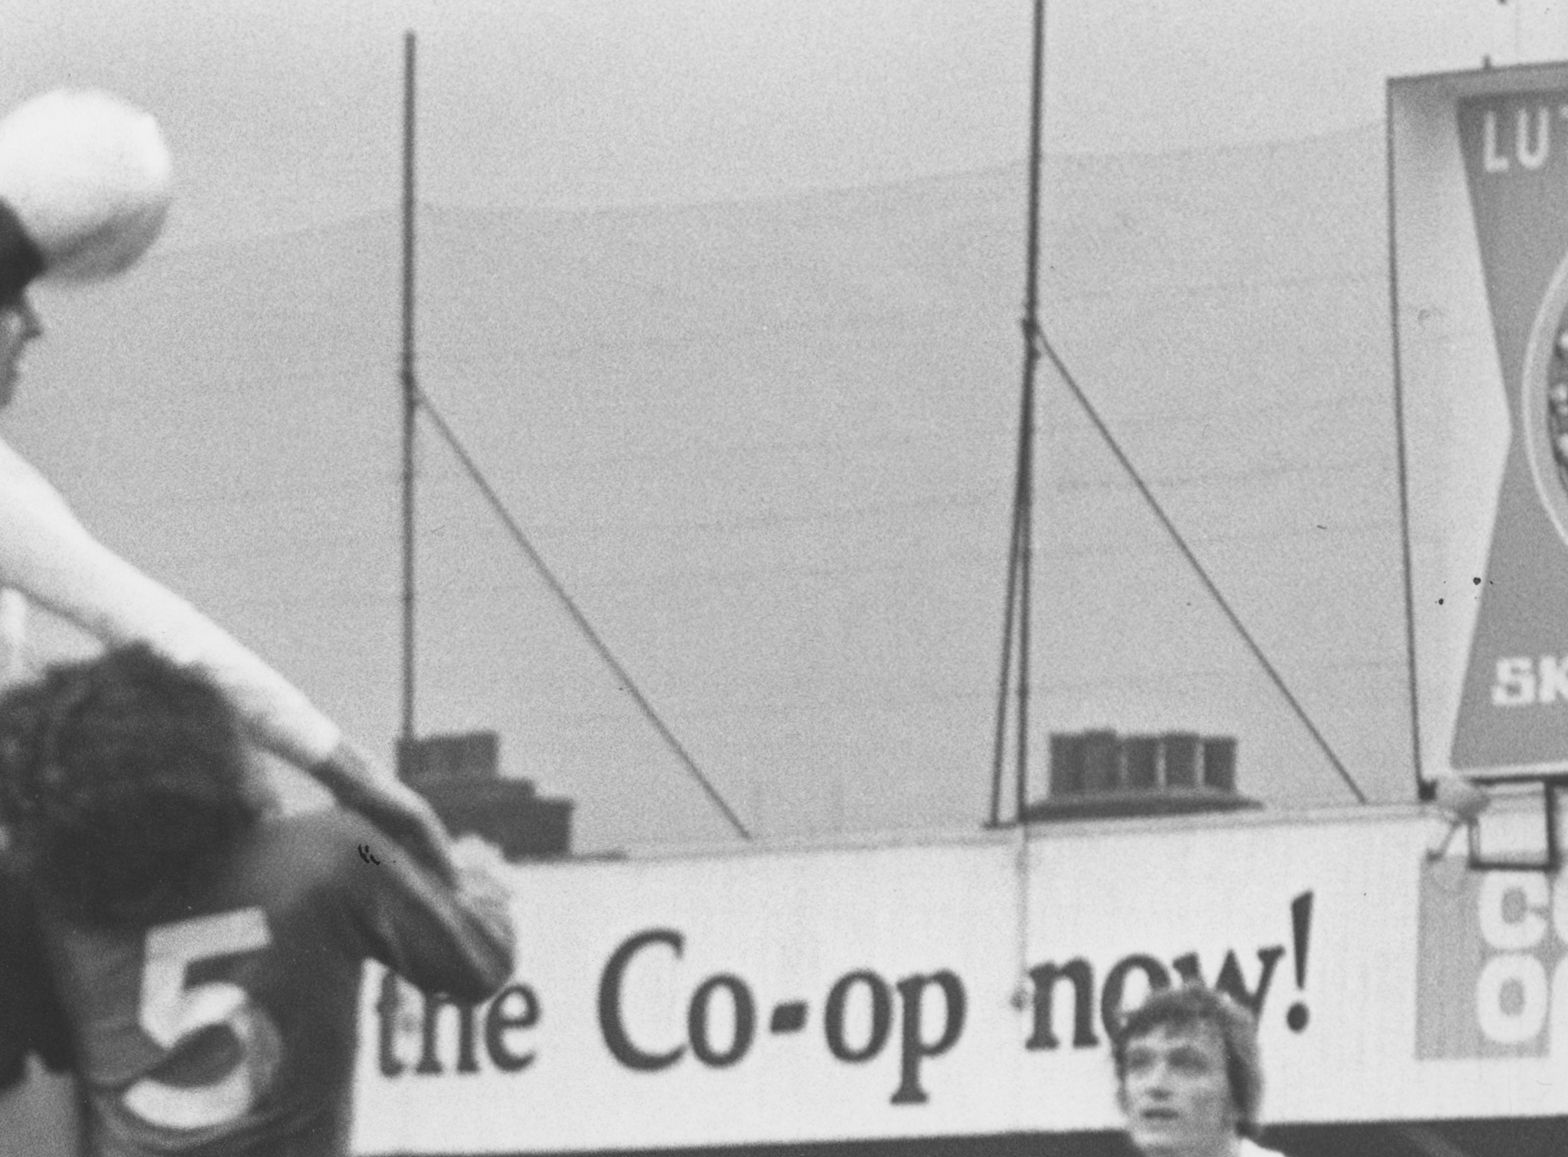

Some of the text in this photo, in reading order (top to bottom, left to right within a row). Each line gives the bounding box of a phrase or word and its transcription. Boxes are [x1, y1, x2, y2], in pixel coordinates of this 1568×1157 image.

[1483, 108, 1568, 174] LU
[1478, 871, 1568, 949] C
[124, 905, 284, 1131] 5
[596, 927, 968, 1106] Co-op
[1025, 889, 1315, 1052] now!
[1476, 953, 1568, 1047] O
